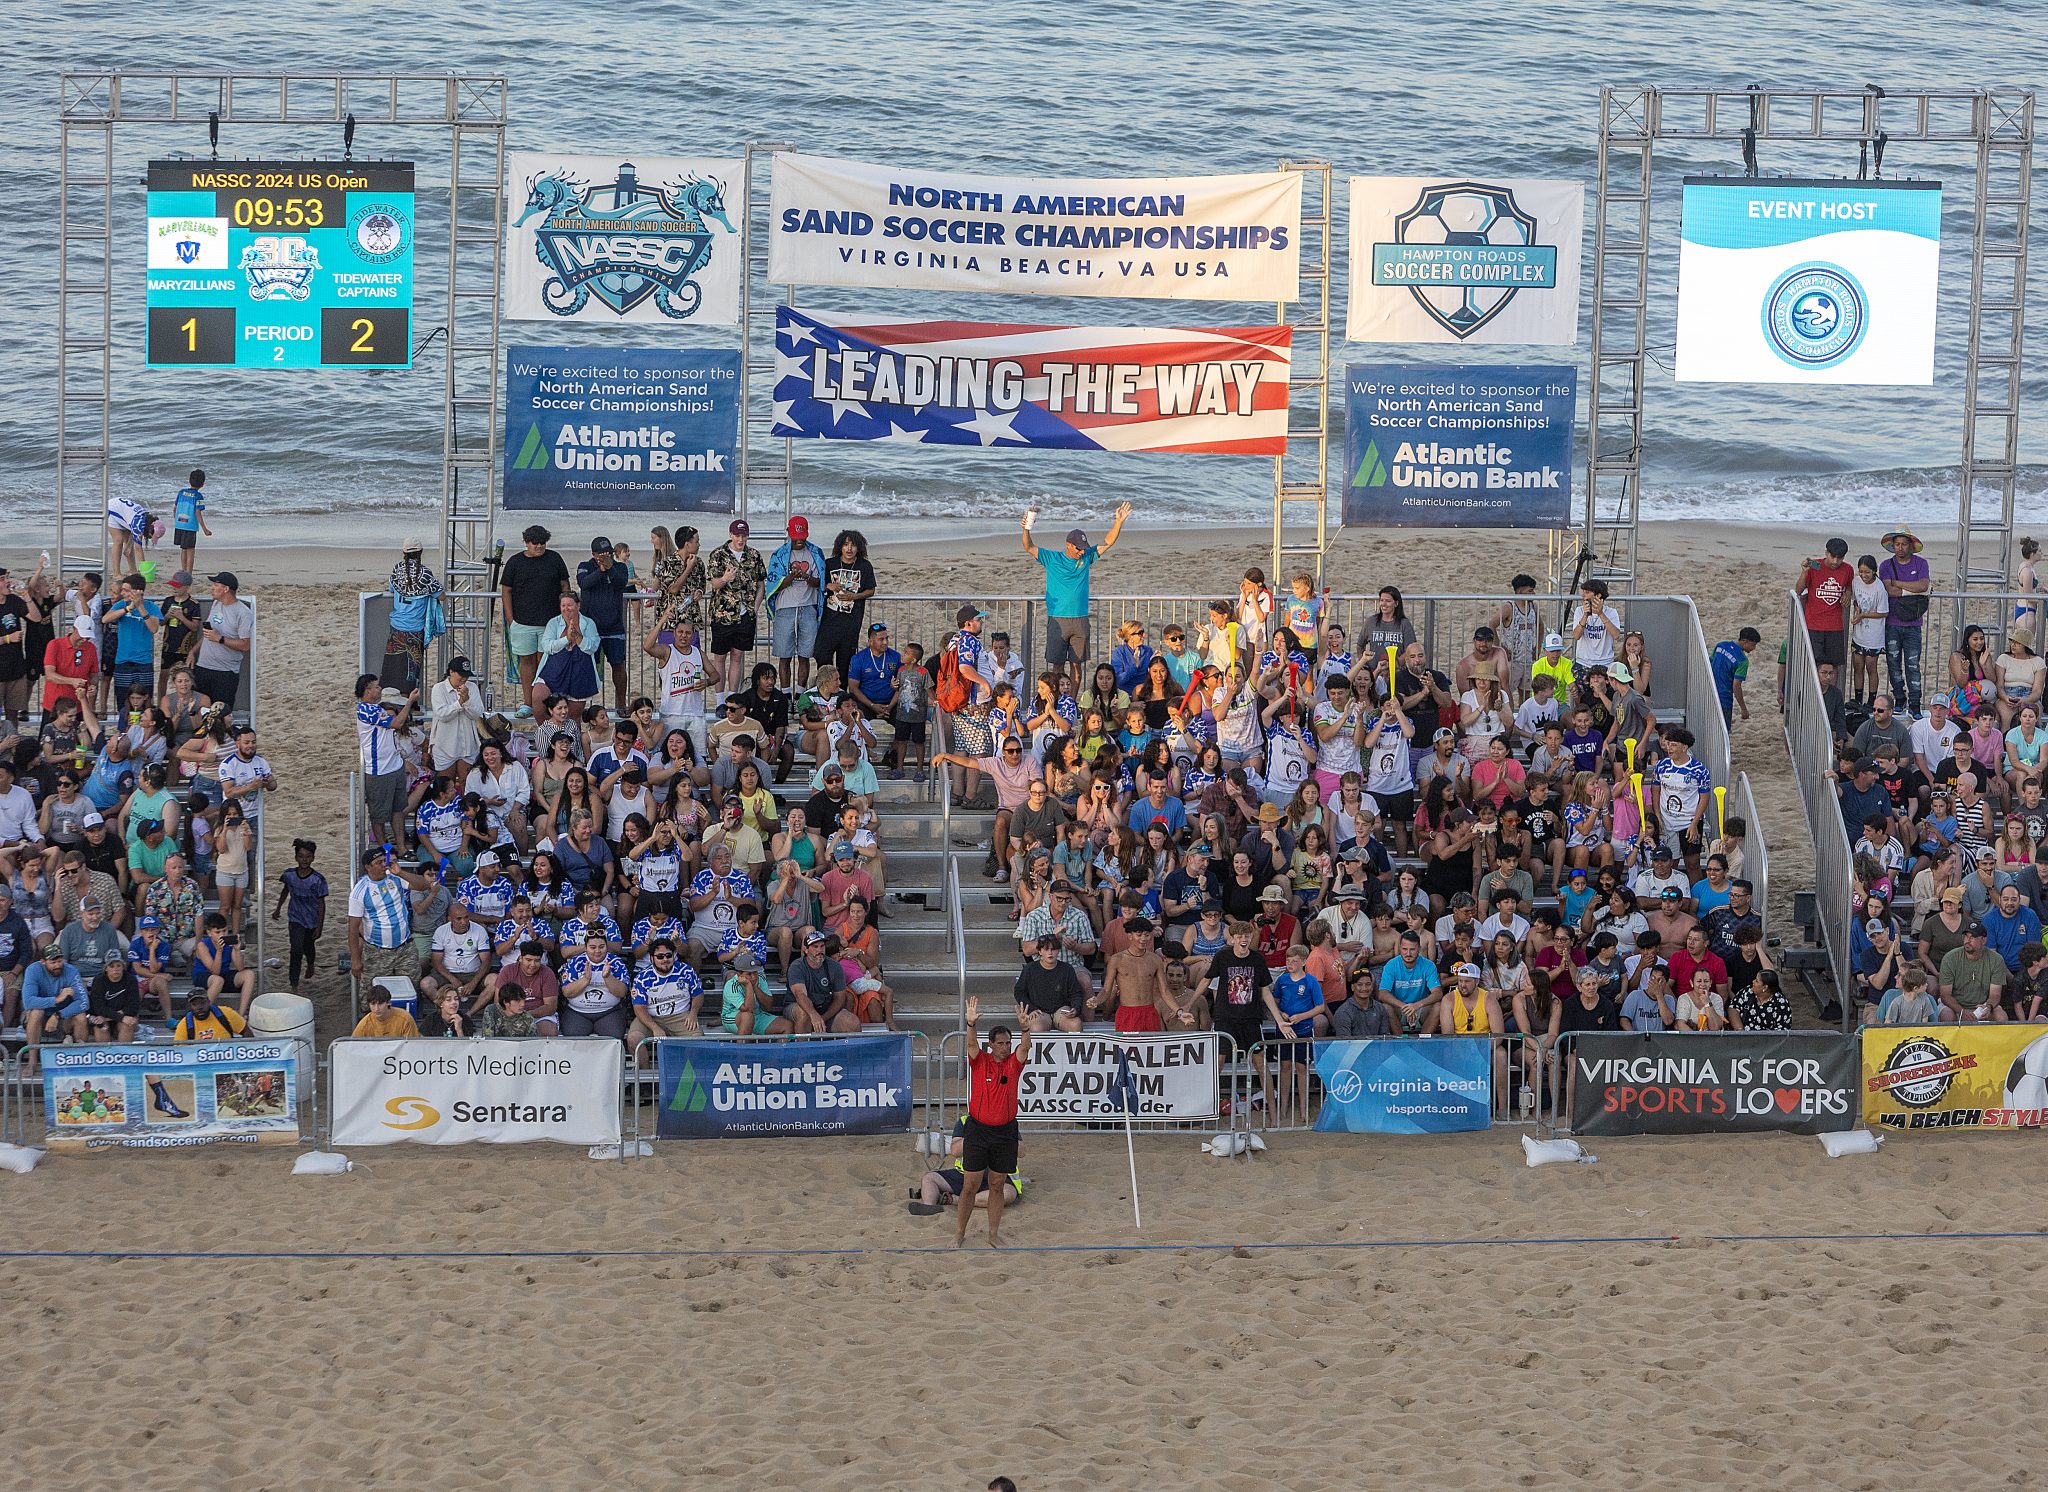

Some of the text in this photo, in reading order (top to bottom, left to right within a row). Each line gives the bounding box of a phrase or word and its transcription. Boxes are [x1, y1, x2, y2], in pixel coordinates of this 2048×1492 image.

[192, 174, 368, 191] NASSC 2024 US Open
[889, 183, 1185, 217] NORTH AMERICAN
[234, 198, 324, 226] 09:53
[1748, 200, 1878, 220] EVENT HOST
[552, 218, 697, 233] NORTH AMERICAN SAND SOCCER
[781, 209, 1289, 251] SAND SOCCER CHAMPIONSHIPS
[179, 243, 196, 258] M
[553, 236, 693, 274] NASSC
[1403, 249, 1526, 262] HAMPTON ROADS
[839, 247, 1230, 279] VIRGINIA BEACH, VA USA
[1383, 262, 1545, 282] SOCCER COMPLEX
[148, 280, 235, 290] MARYZILLIANS
[332, 273, 402, 284] TIDEWATER
[572, 265, 673, 286] CHAMPIONSHIPS
[337, 287, 397, 298] CAPTAINS
[181, 317, 196, 351] 1
[244, 326, 314, 341] PERIOD
[350, 318, 375, 352] 2
[273, 347, 285, 361] 2
[513, 363, 735, 382] We're excited to sponsor the
[811, 348, 1264, 416] LEADING THE WAY
[539, 380, 708, 396] North American Sand
[1352, 382, 1570, 399] We're excited to sponsor the
[532, 397, 714, 413] Soccer Championships!
[1378, 399, 1543, 412] North American Sand
[1370, 415, 1550, 430] Soccer Championships!
[555, 424, 676, 447] Atlantic
[554, 449, 642, 471] Union
[1393, 442, 1512, 465] Atlantic
[565, 481, 676, 491] AtlanticUnionBank.com
[1392, 465, 1478, 488] Union
[1402, 498, 1512, 507] AtlanticUnionBank.com
[1372, 632, 1403, 644] TAR HEELS
[1572, 742, 1597, 755] REIGN
[456, 948, 464, 957] 2
[56, 1049, 183, 1066] Sand Soccer Balls
[198, 1046, 281, 1062] Sand Socks
[1065, 1042, 1205, 1068] WHALEN
[1904, 1045, 1931, 1056] PIZZA
[383, 1055, 571, 1080] Sports Medicine
[712, 1061, 844, 1085] Atlantic
[1578, 1057, 1826, 1085] VIRGINIA IS FOR
[1868, 1054, 1978, 1092] SHOREBREAK
[1021, 1071, 1165, 1097] STADIM
[1367, 1076, 1487, 1096] virginia beach
[1902, 1083, 1943, 1102] TAPHOUSE
[712, 1086, 806, 1111] Union
[1018, 1099, 1174, 1114] NASSC Fouder
[1603, 1086, 1727, 1114] SPORTS
[452, 1101, 567, 1123] Sentara
[1386, 1104, 1468, 1115] vbsports.com
[1880, 1107, 2048, 1130] VA BEACH STYLE
[724, 1121, 845, 1131] AtlanticUnionBank.com
